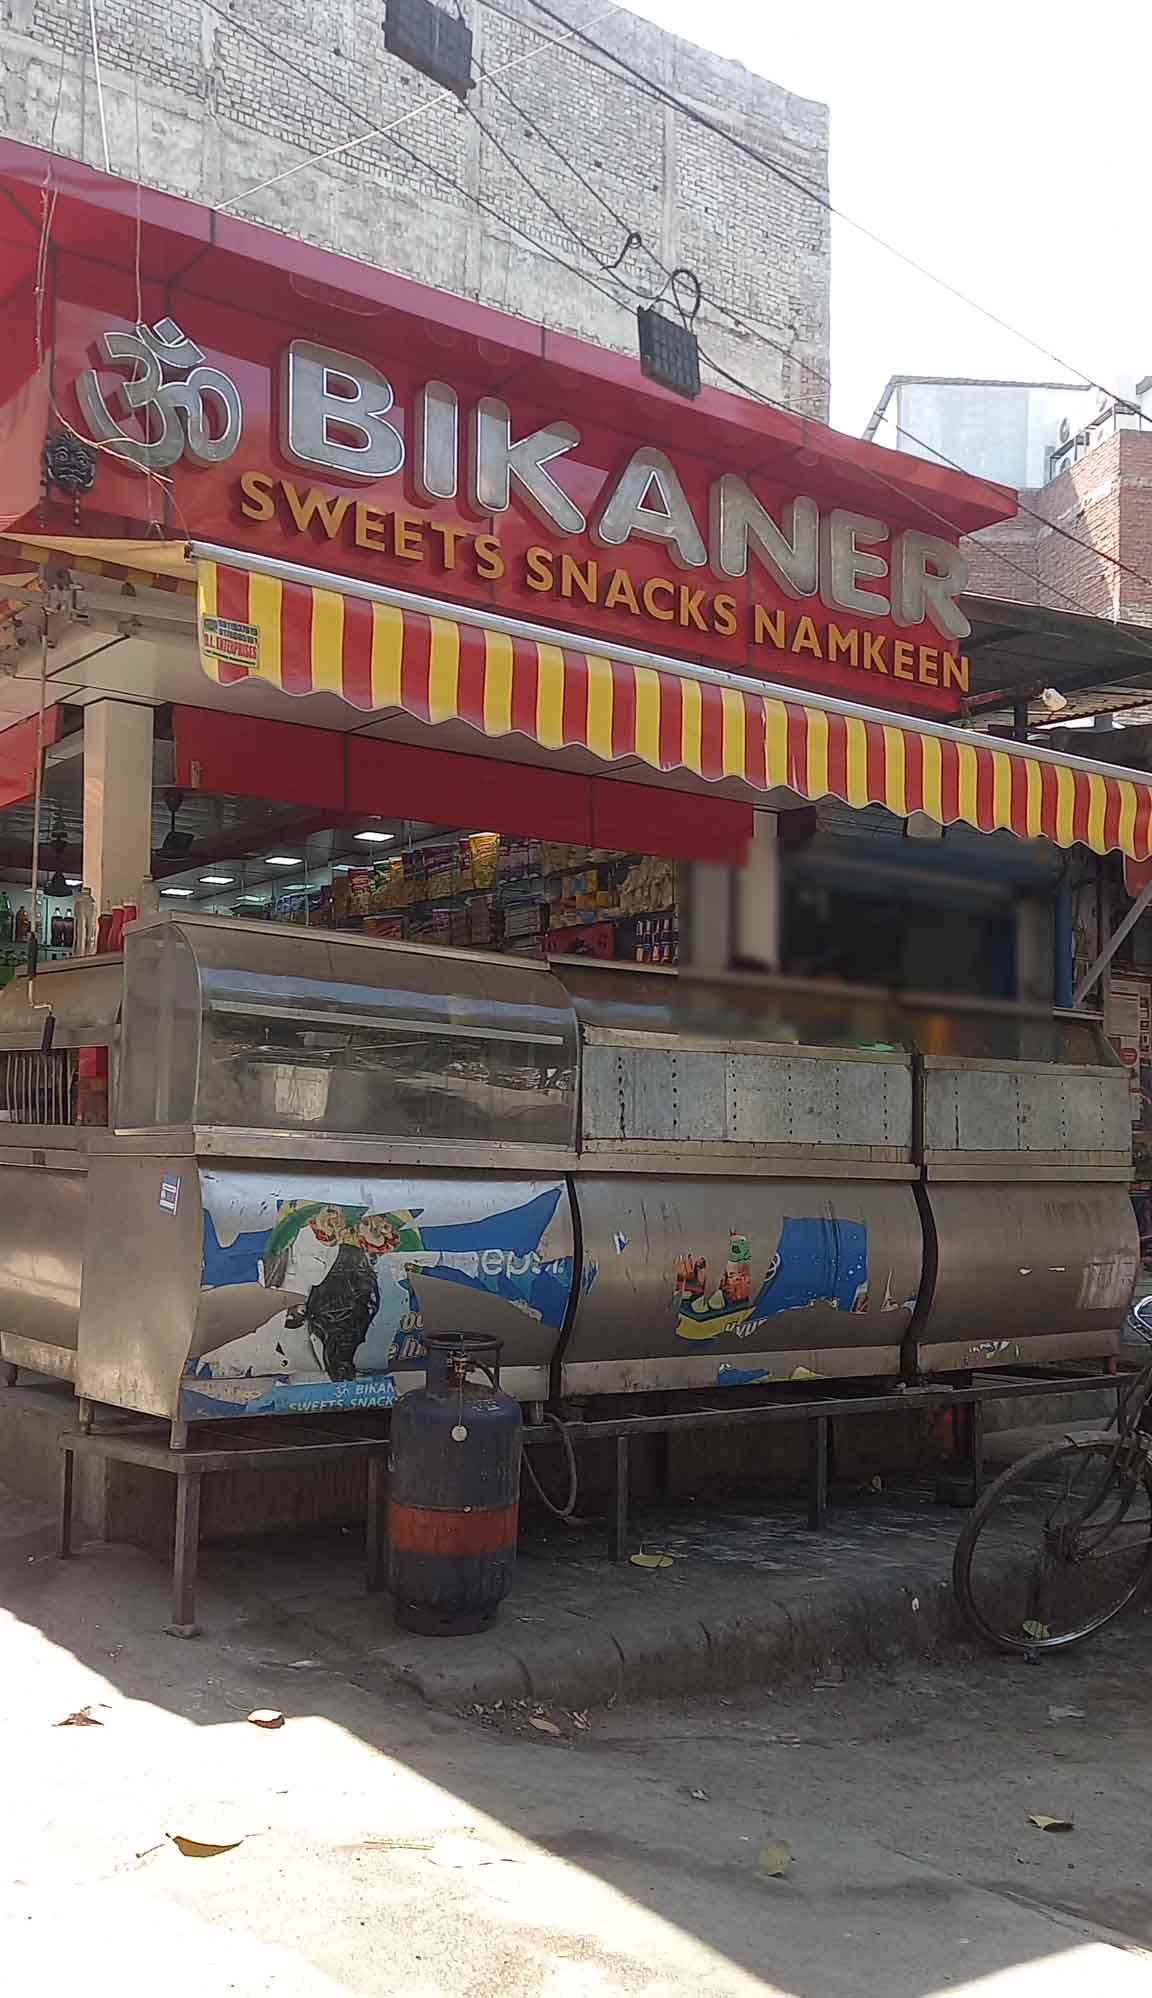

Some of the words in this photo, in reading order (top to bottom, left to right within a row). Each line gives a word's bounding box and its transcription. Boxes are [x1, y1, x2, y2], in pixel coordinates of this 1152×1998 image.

[240, 471, 505, 580] SWEETS
[525, 546, 739, 637] SNACKS
[753, 604, 970, 693] NAMKEEN
[280, 338, 971, 640] BIKANER
[289, 1399, 344, 1413] SWEETS
